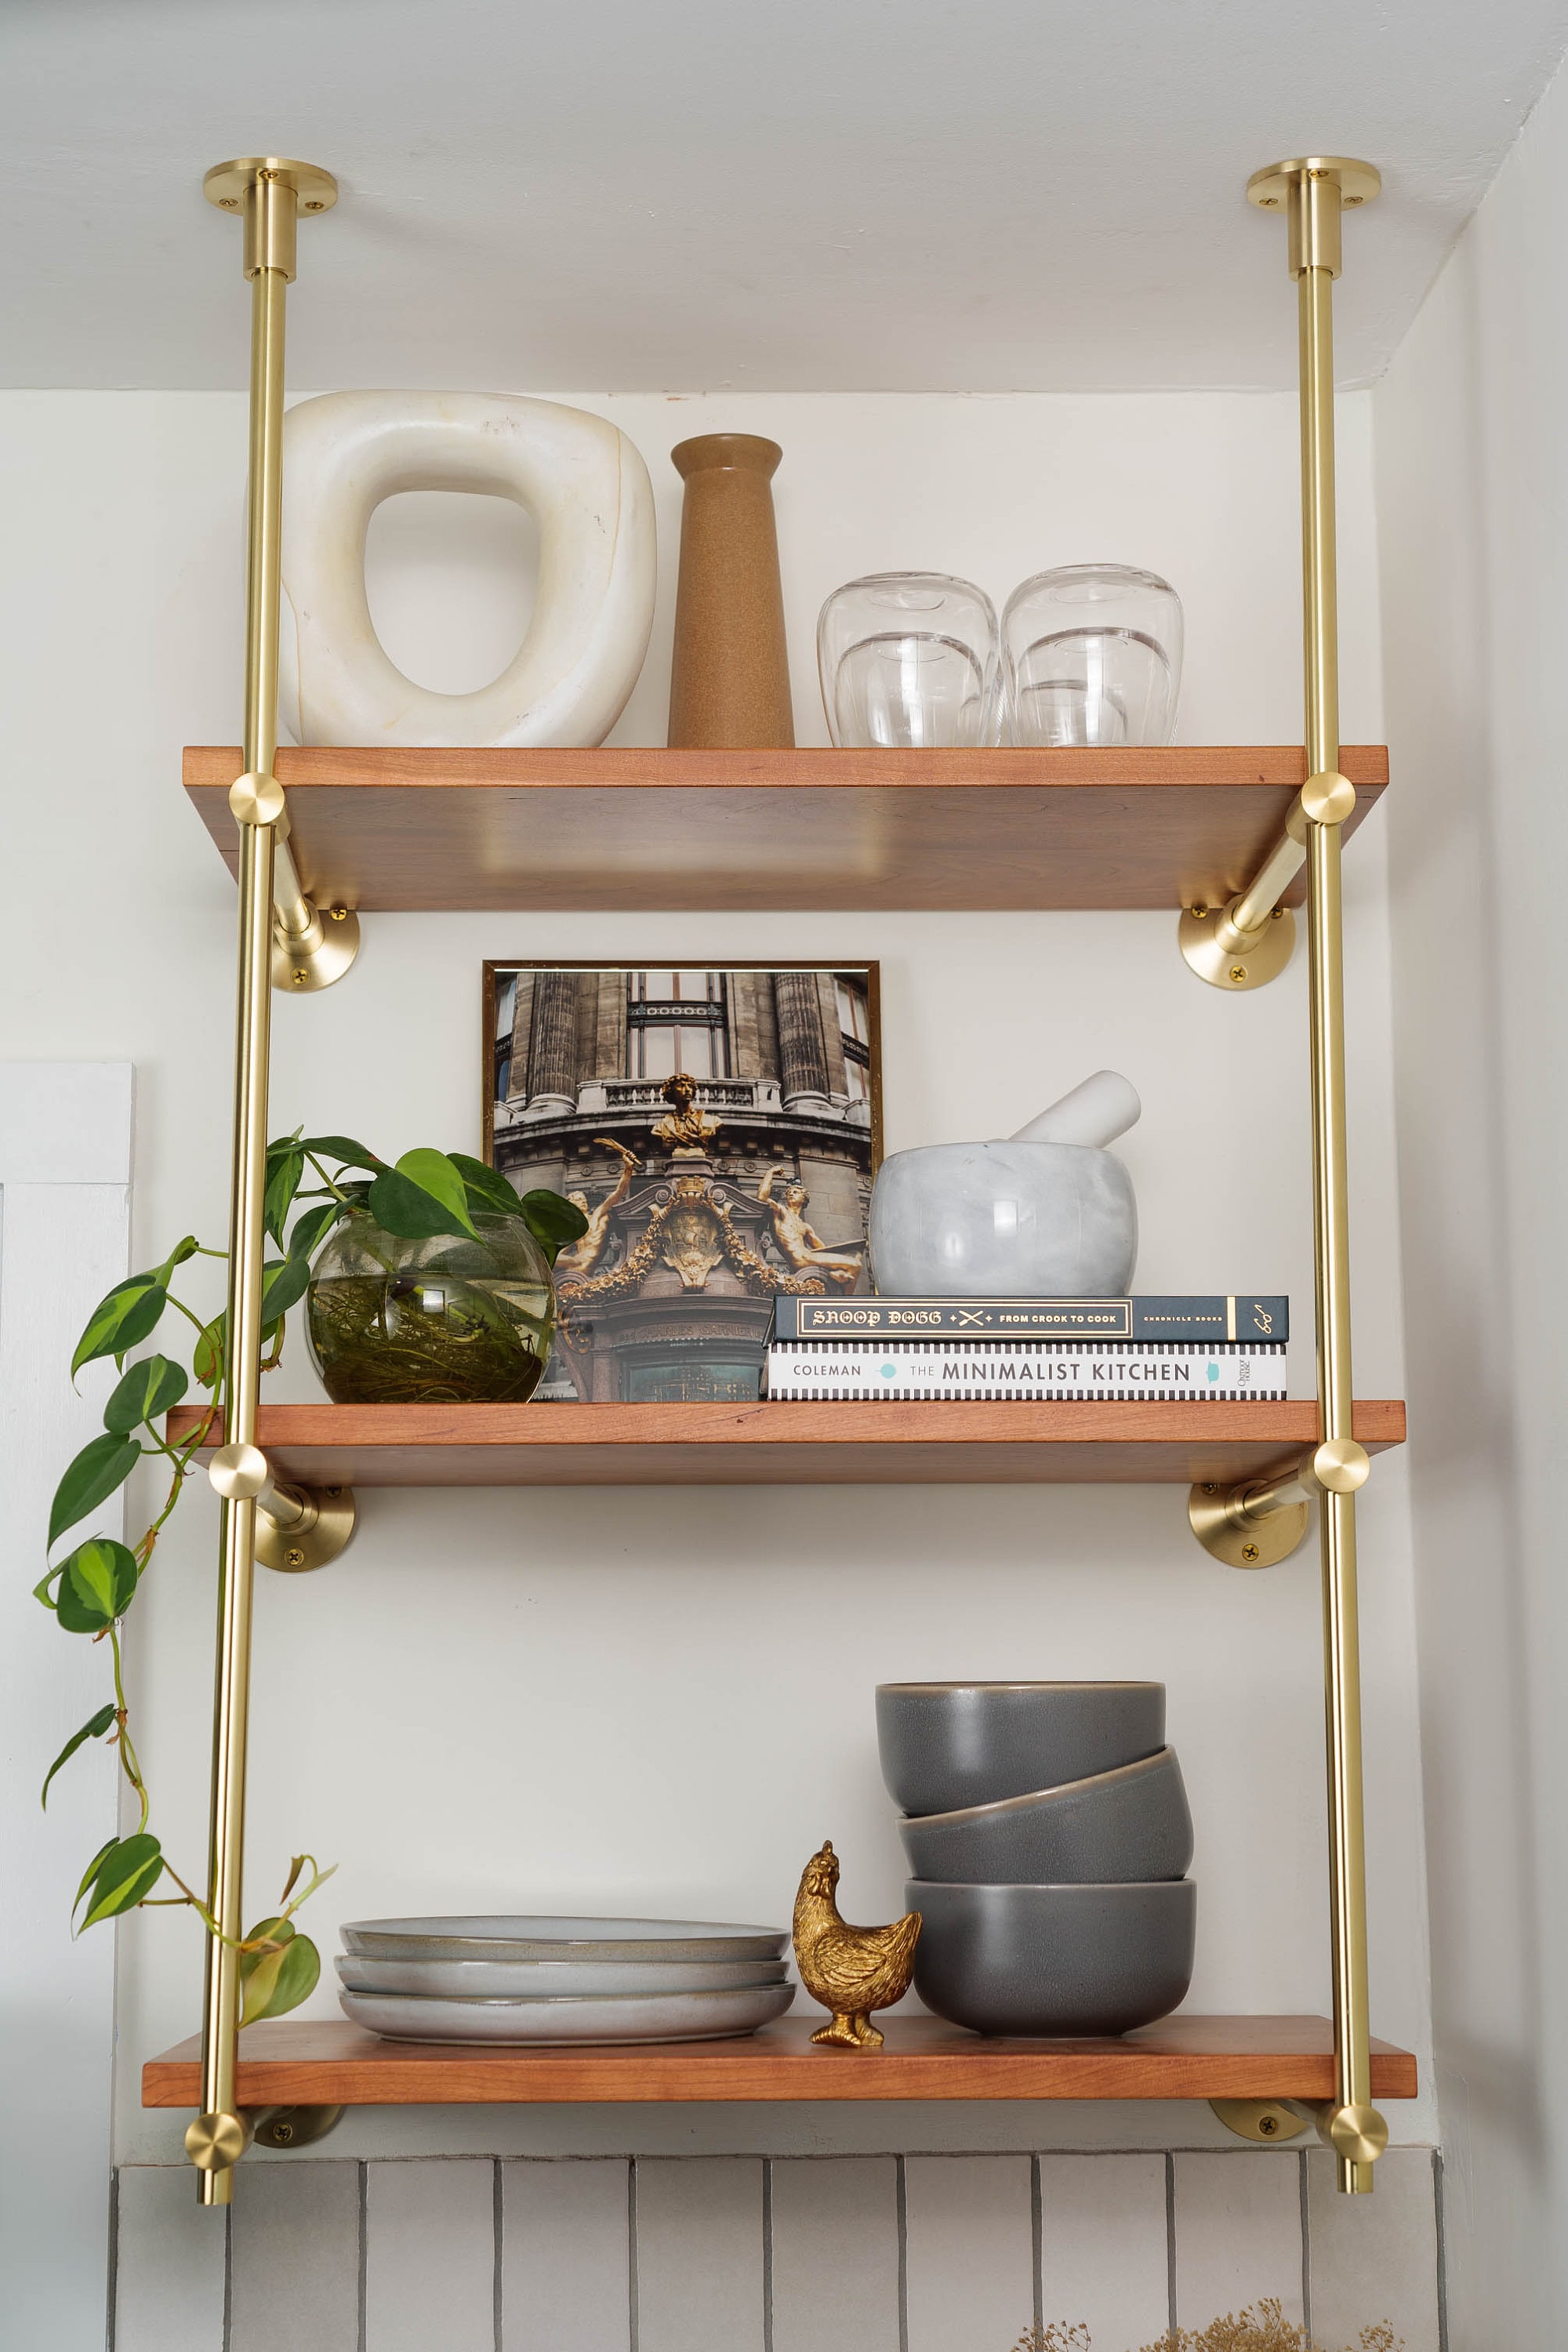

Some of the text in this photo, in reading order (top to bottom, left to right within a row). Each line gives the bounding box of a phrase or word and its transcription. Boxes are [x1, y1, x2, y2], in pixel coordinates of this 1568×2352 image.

[812, 1310, 942, 1327] SNOOP DOGG
[793, 1365, 861, 1376] COLEMAN
[910, 1363, 1189, 1381] THE MINIMALIST KITCHEN
